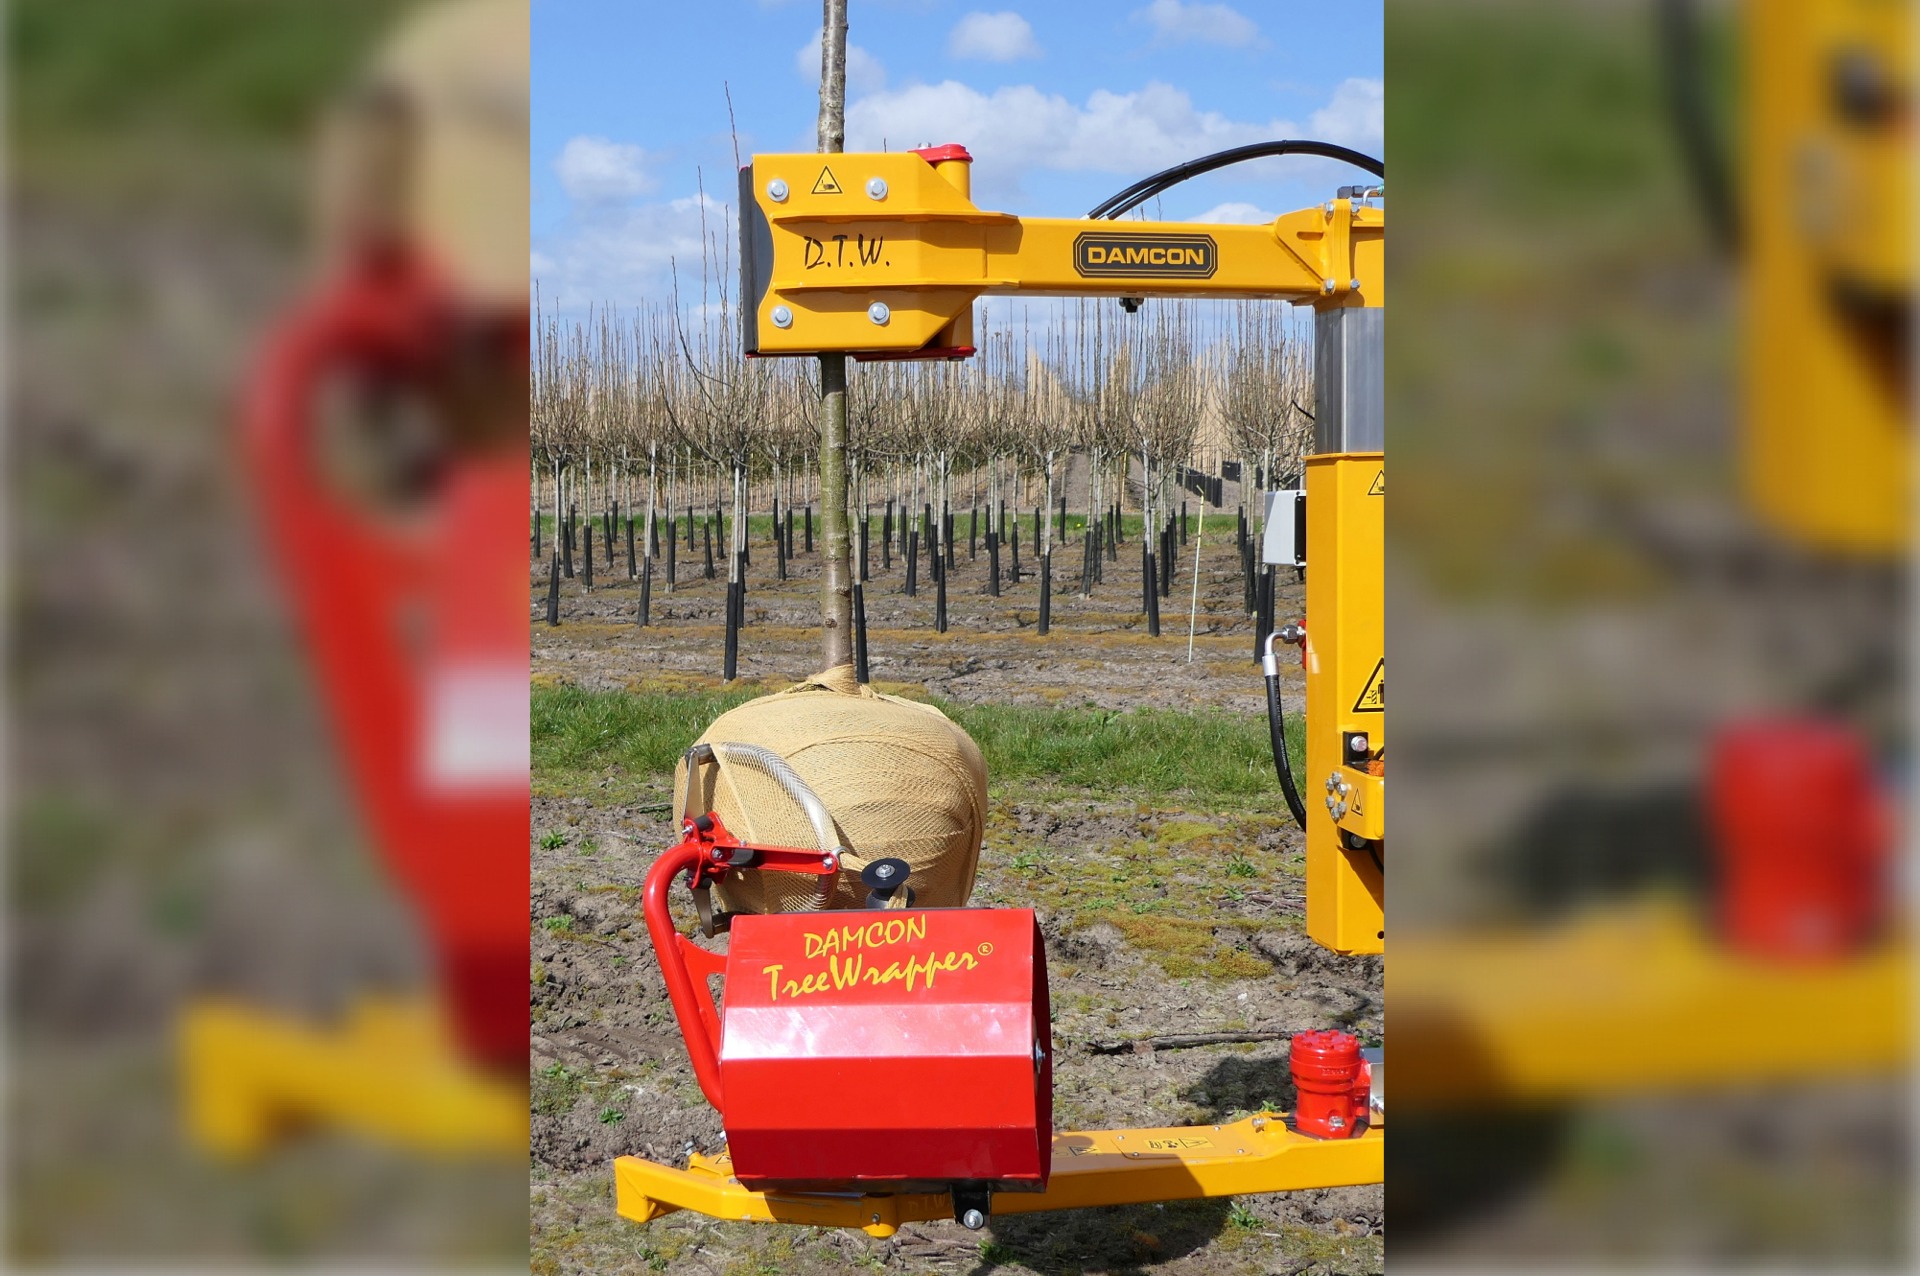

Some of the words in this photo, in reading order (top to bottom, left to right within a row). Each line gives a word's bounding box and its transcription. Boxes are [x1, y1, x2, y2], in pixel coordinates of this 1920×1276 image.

[803, 233, 891, 270] D.T.W.
[1087, 246, 1204, 265] DAMCON
[803, 913, 927, 959] DAMCON
[907, 1194, 950, 1215] DT.W.
